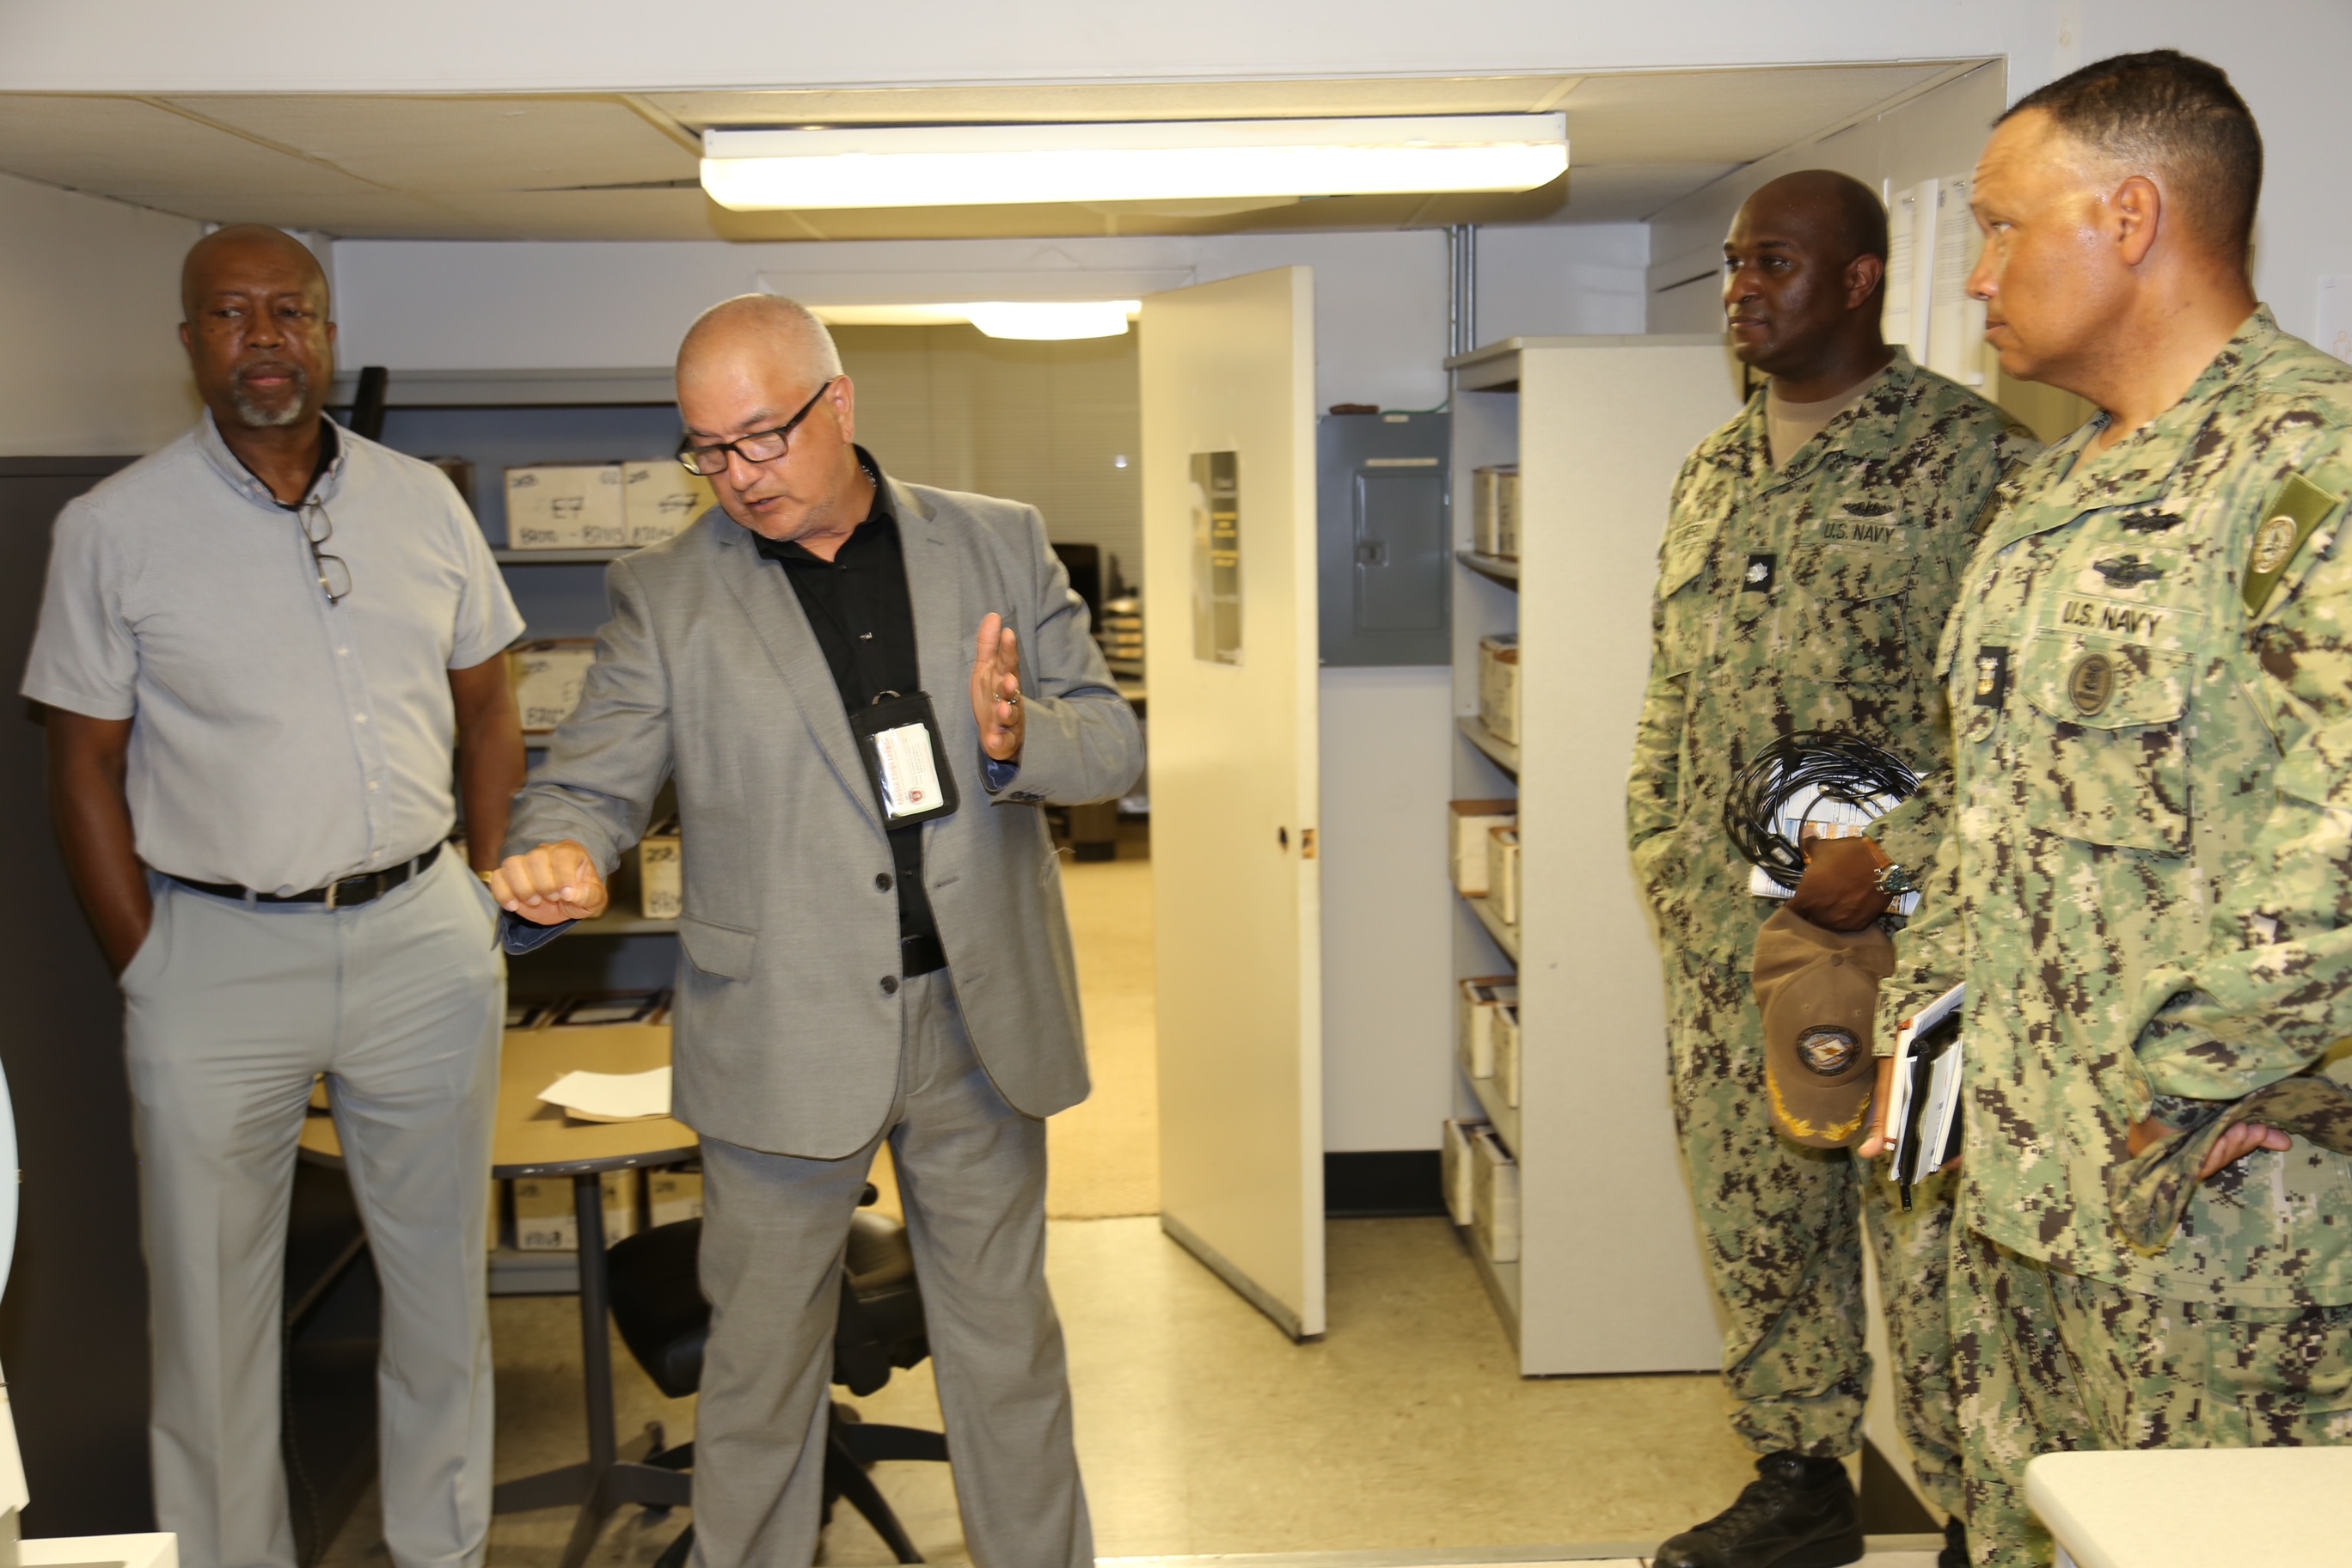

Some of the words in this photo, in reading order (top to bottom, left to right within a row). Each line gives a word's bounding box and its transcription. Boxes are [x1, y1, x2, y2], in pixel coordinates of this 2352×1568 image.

[1823, 522, 1848, 539] U.S.
[1853, 523, 1896, 544] NAVY
[2063, 600, 2095, 627] U.S.
[2098, 606, 2163, 637] NAVY
